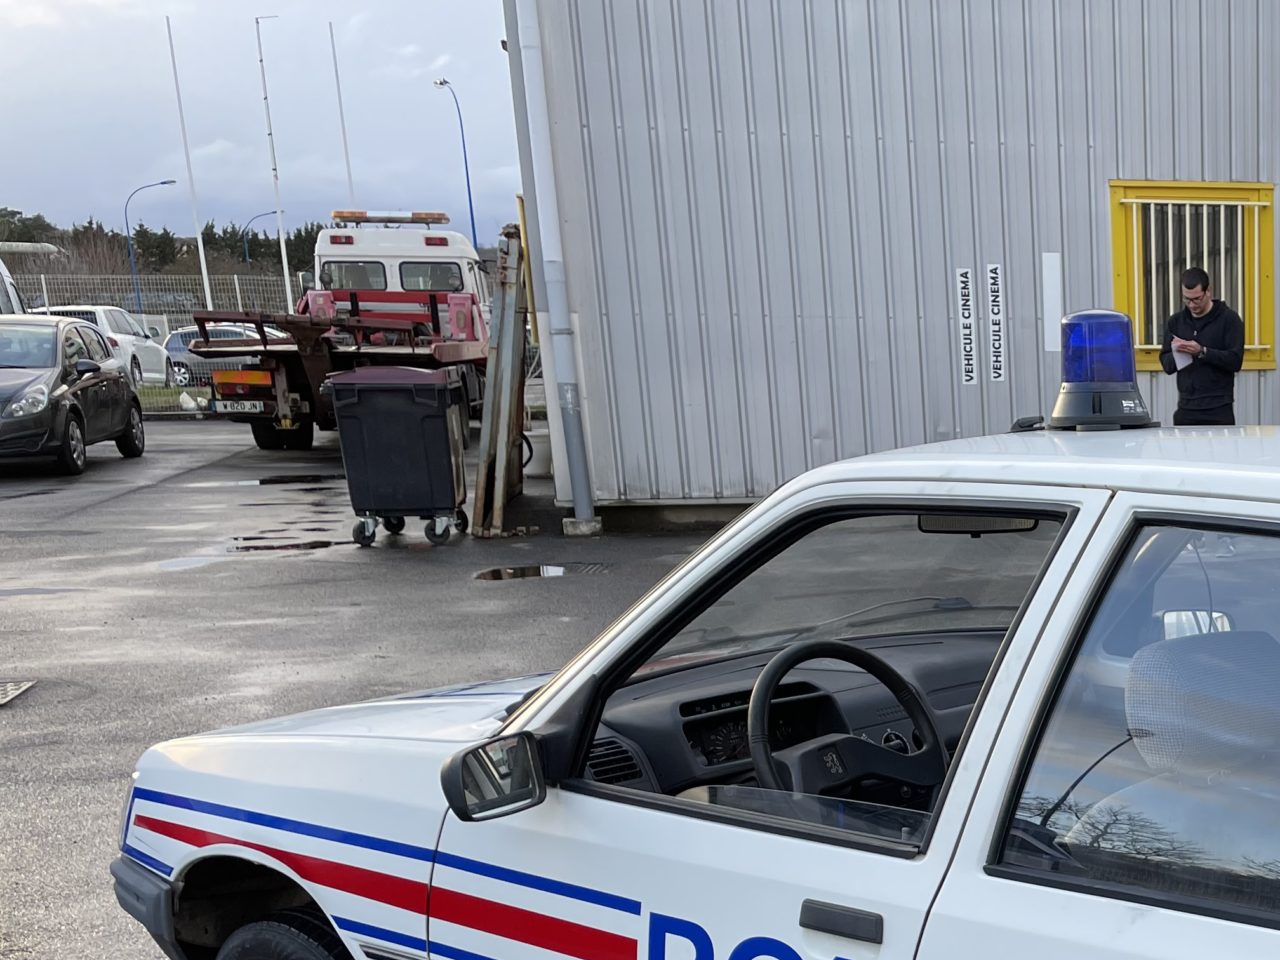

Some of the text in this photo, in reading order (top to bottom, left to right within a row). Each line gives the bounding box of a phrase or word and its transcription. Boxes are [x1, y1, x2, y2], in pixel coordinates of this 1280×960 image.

[961, 271, 974, 383] VEHICULE CINEMA
[990, 266, 1002, 380] VEHICULE CINEMA
